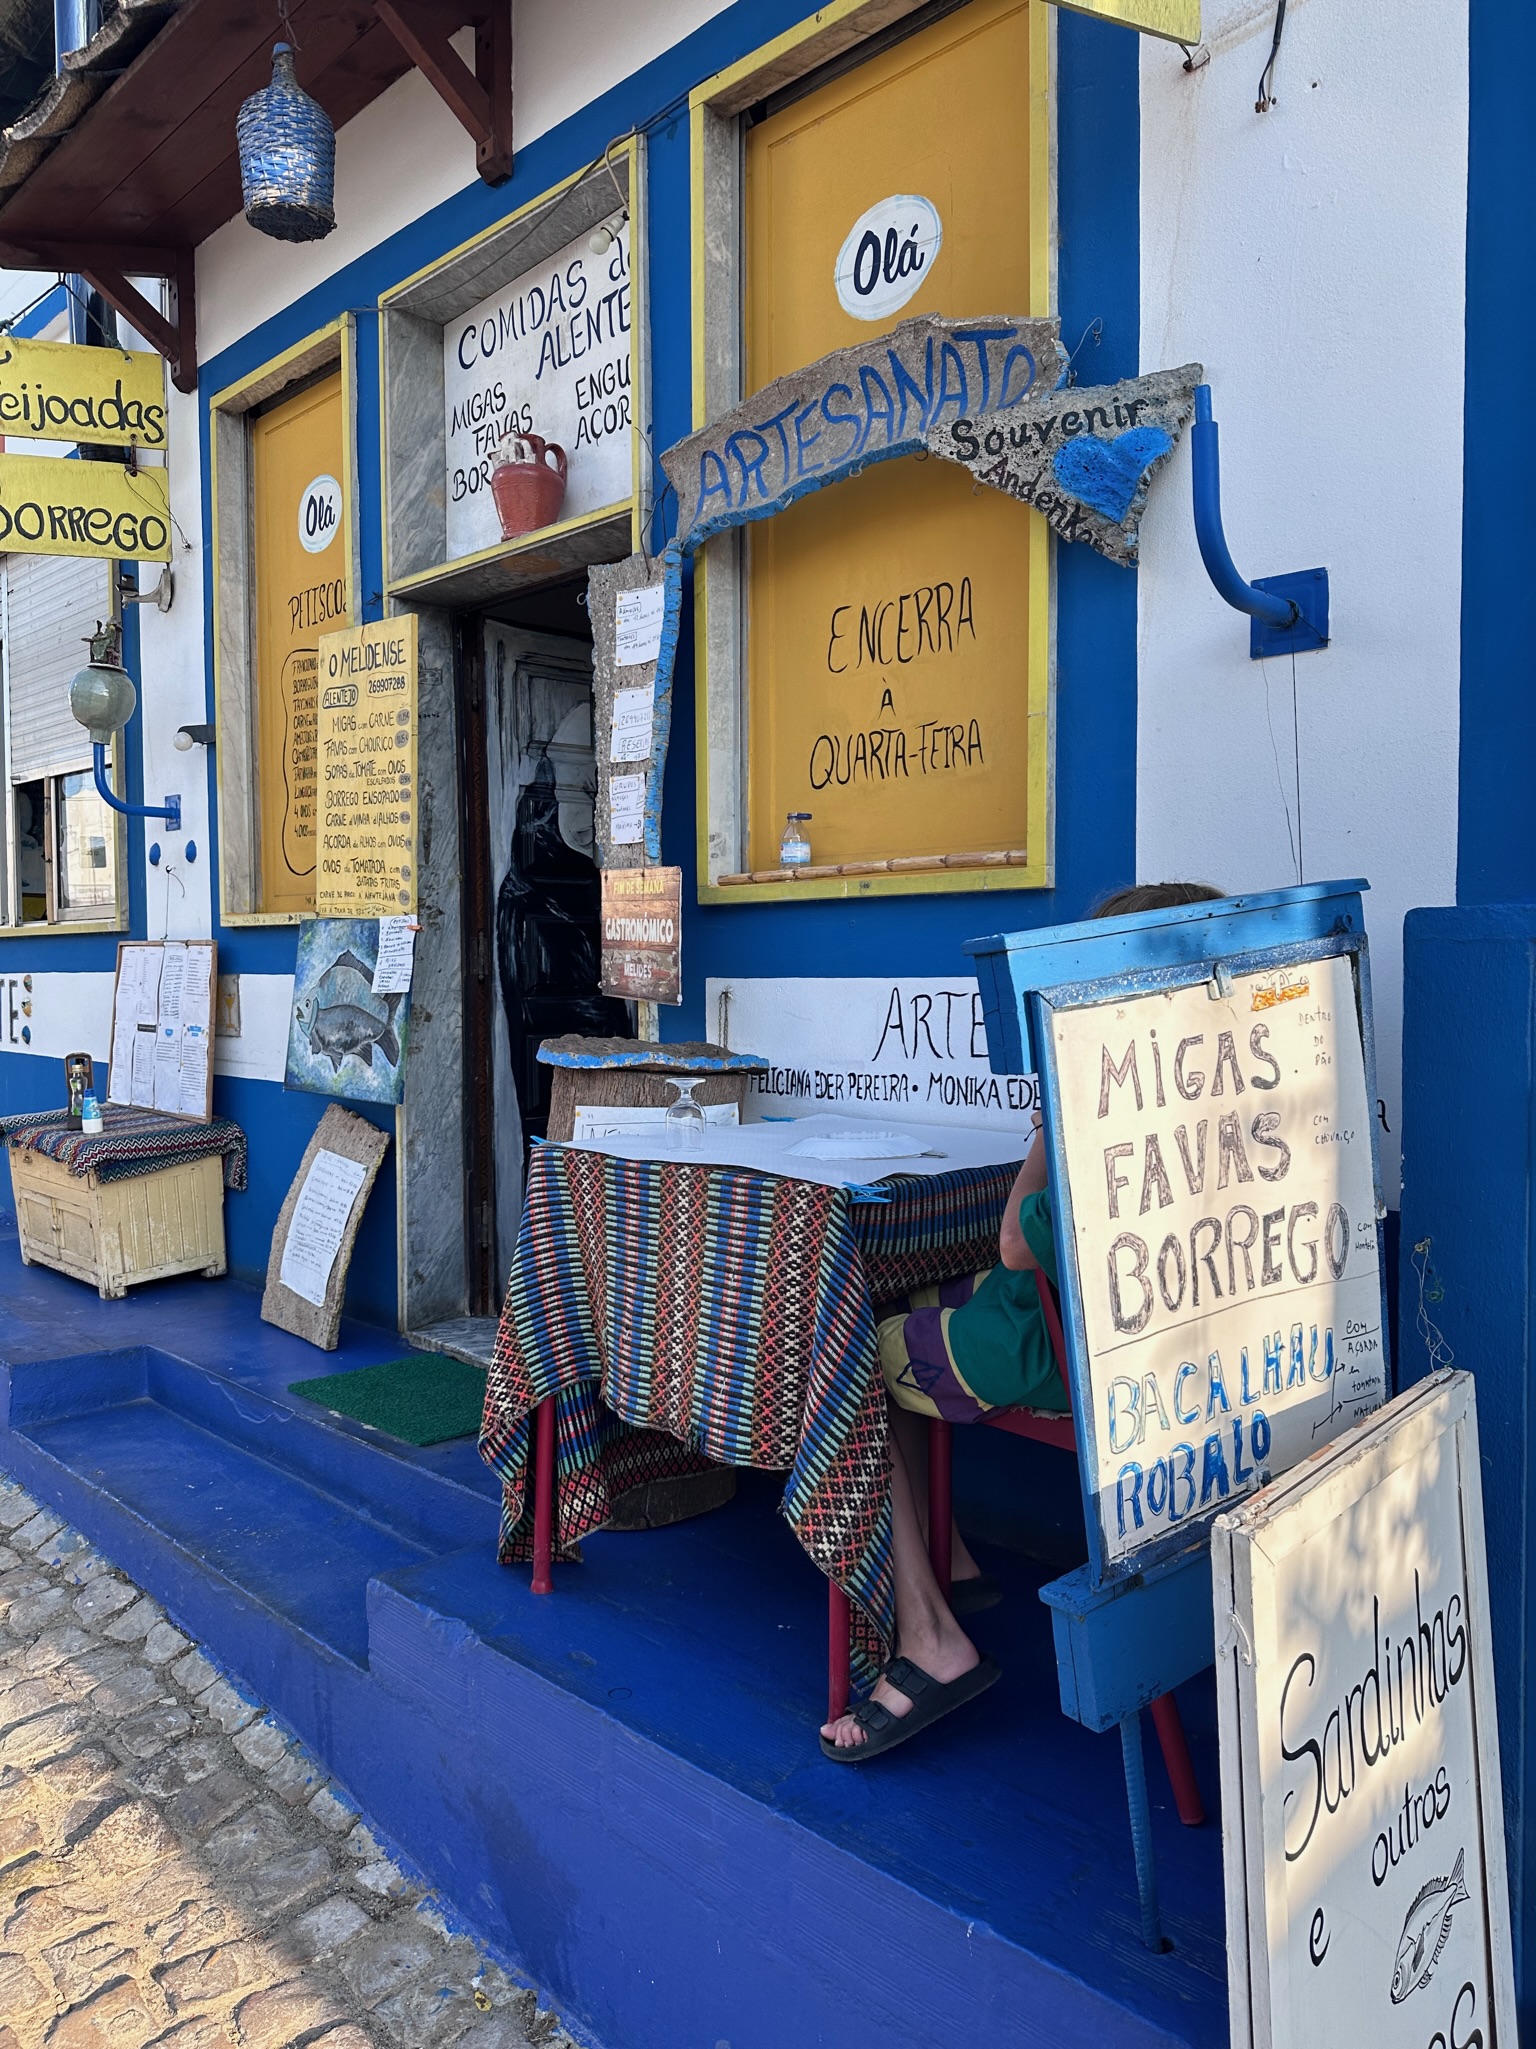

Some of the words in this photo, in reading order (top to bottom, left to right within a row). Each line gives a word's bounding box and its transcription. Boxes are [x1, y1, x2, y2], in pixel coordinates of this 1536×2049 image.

[854, 224, 925, 295] Olá
[458, 259, 587, 370] COMIDAS
[609, 236, 631, 281] d
[536, 282, 631, 380] ALENTE
[0, 352, 165, 443] eijoadas
[575, 353, 631, 410] ENGU
[451, 382, 506, 437] MIGAS
[472, 403, 533, 456] FAVAS
[689, 328, 1036, 530] ARTESANATO
[952, 394, 1149, 461] Souvenir
[452, 461, 491, 502] BOR
[306, 495, 335, 536] Olá
[828, 577, 976, 673] ENCERRA
[329, 654, 337, 677] O
[340, 639, 406, 678] MELIDENSE
[368, 676, 405, 693] 269907288
[324, 689, 356, 706] ALENTEJO
[333, 715, 356, 733] MIGAS
[368, 711, 395, 728] CARNE
[878, 677, 896, 719] À
[324, 738, 348, 759] FAVAS
[348, 747, 357, 755] com
[325, 764, 348, 781] SOPAS
[353, 759, 376, 778] TOMATE
[387, 759, 406, 775] OVOS
[810, 719, 984, 789] QUARTA-FEIRA
[325, 790, 359, 809] BORREGO
[362, 789, 399, 806] ENSOPADO
[325, 812, 347, 827] CARNE
[322, 859, 341, 874] OVOS
[350, 857, 386, 874] TOMATADA
[387, 834, 406, 849] OVOS
[380, 877, 400, 890] FRITAS
[605, 912, 674, 943] GASTRONÓMICO
[624, 962, 652, 979] MELIDES
[871, 987, 989, 1061] ARTE
[815, 1070, 844, 1101] EDER
[847, 1072, 909, 1102] PEREIRA
[927, 1072, 1002, 1110] MONIKA
[1103, 1110, 1291, 1219] FAVAS
[1107, 1201, 1350, 1334] BORREGO
[1108, 1322, 1334, 1454] BACALHAU
[1117, 1410, 1271, 1539] ROBALO
[1280, 1568, 1467, 1861] Sardinhas
[1371, 1766, 1450, 1887] outros
[1308, 1906, 1331, 1967] e
